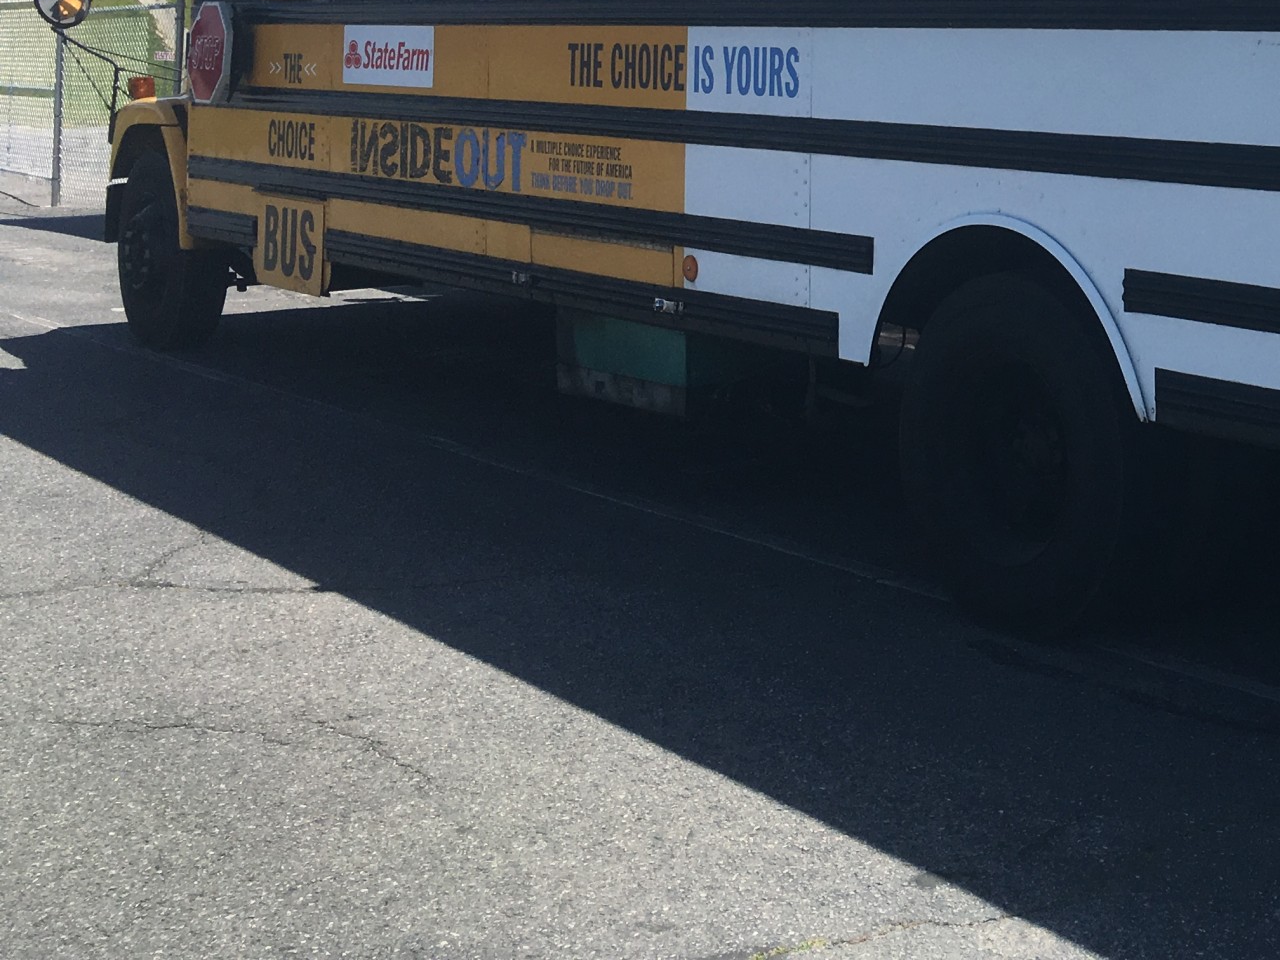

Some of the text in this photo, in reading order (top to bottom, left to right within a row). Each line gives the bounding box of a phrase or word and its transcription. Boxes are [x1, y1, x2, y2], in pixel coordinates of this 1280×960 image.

[191, 35, 221, 71] STOP
[283, 53, 303, 84] THE
[568, 42, 799, 98] THE CHOICE IS YOURS
[268, 119, 316, 161] CHOICE
[530, 139, 622, 161] A MULTIPLE CHOICE EXPERIENCE
[548, 157, 633, 179] FOR THE FUTURE OF AMERICA
[263, 204, 317, 281] BUS
